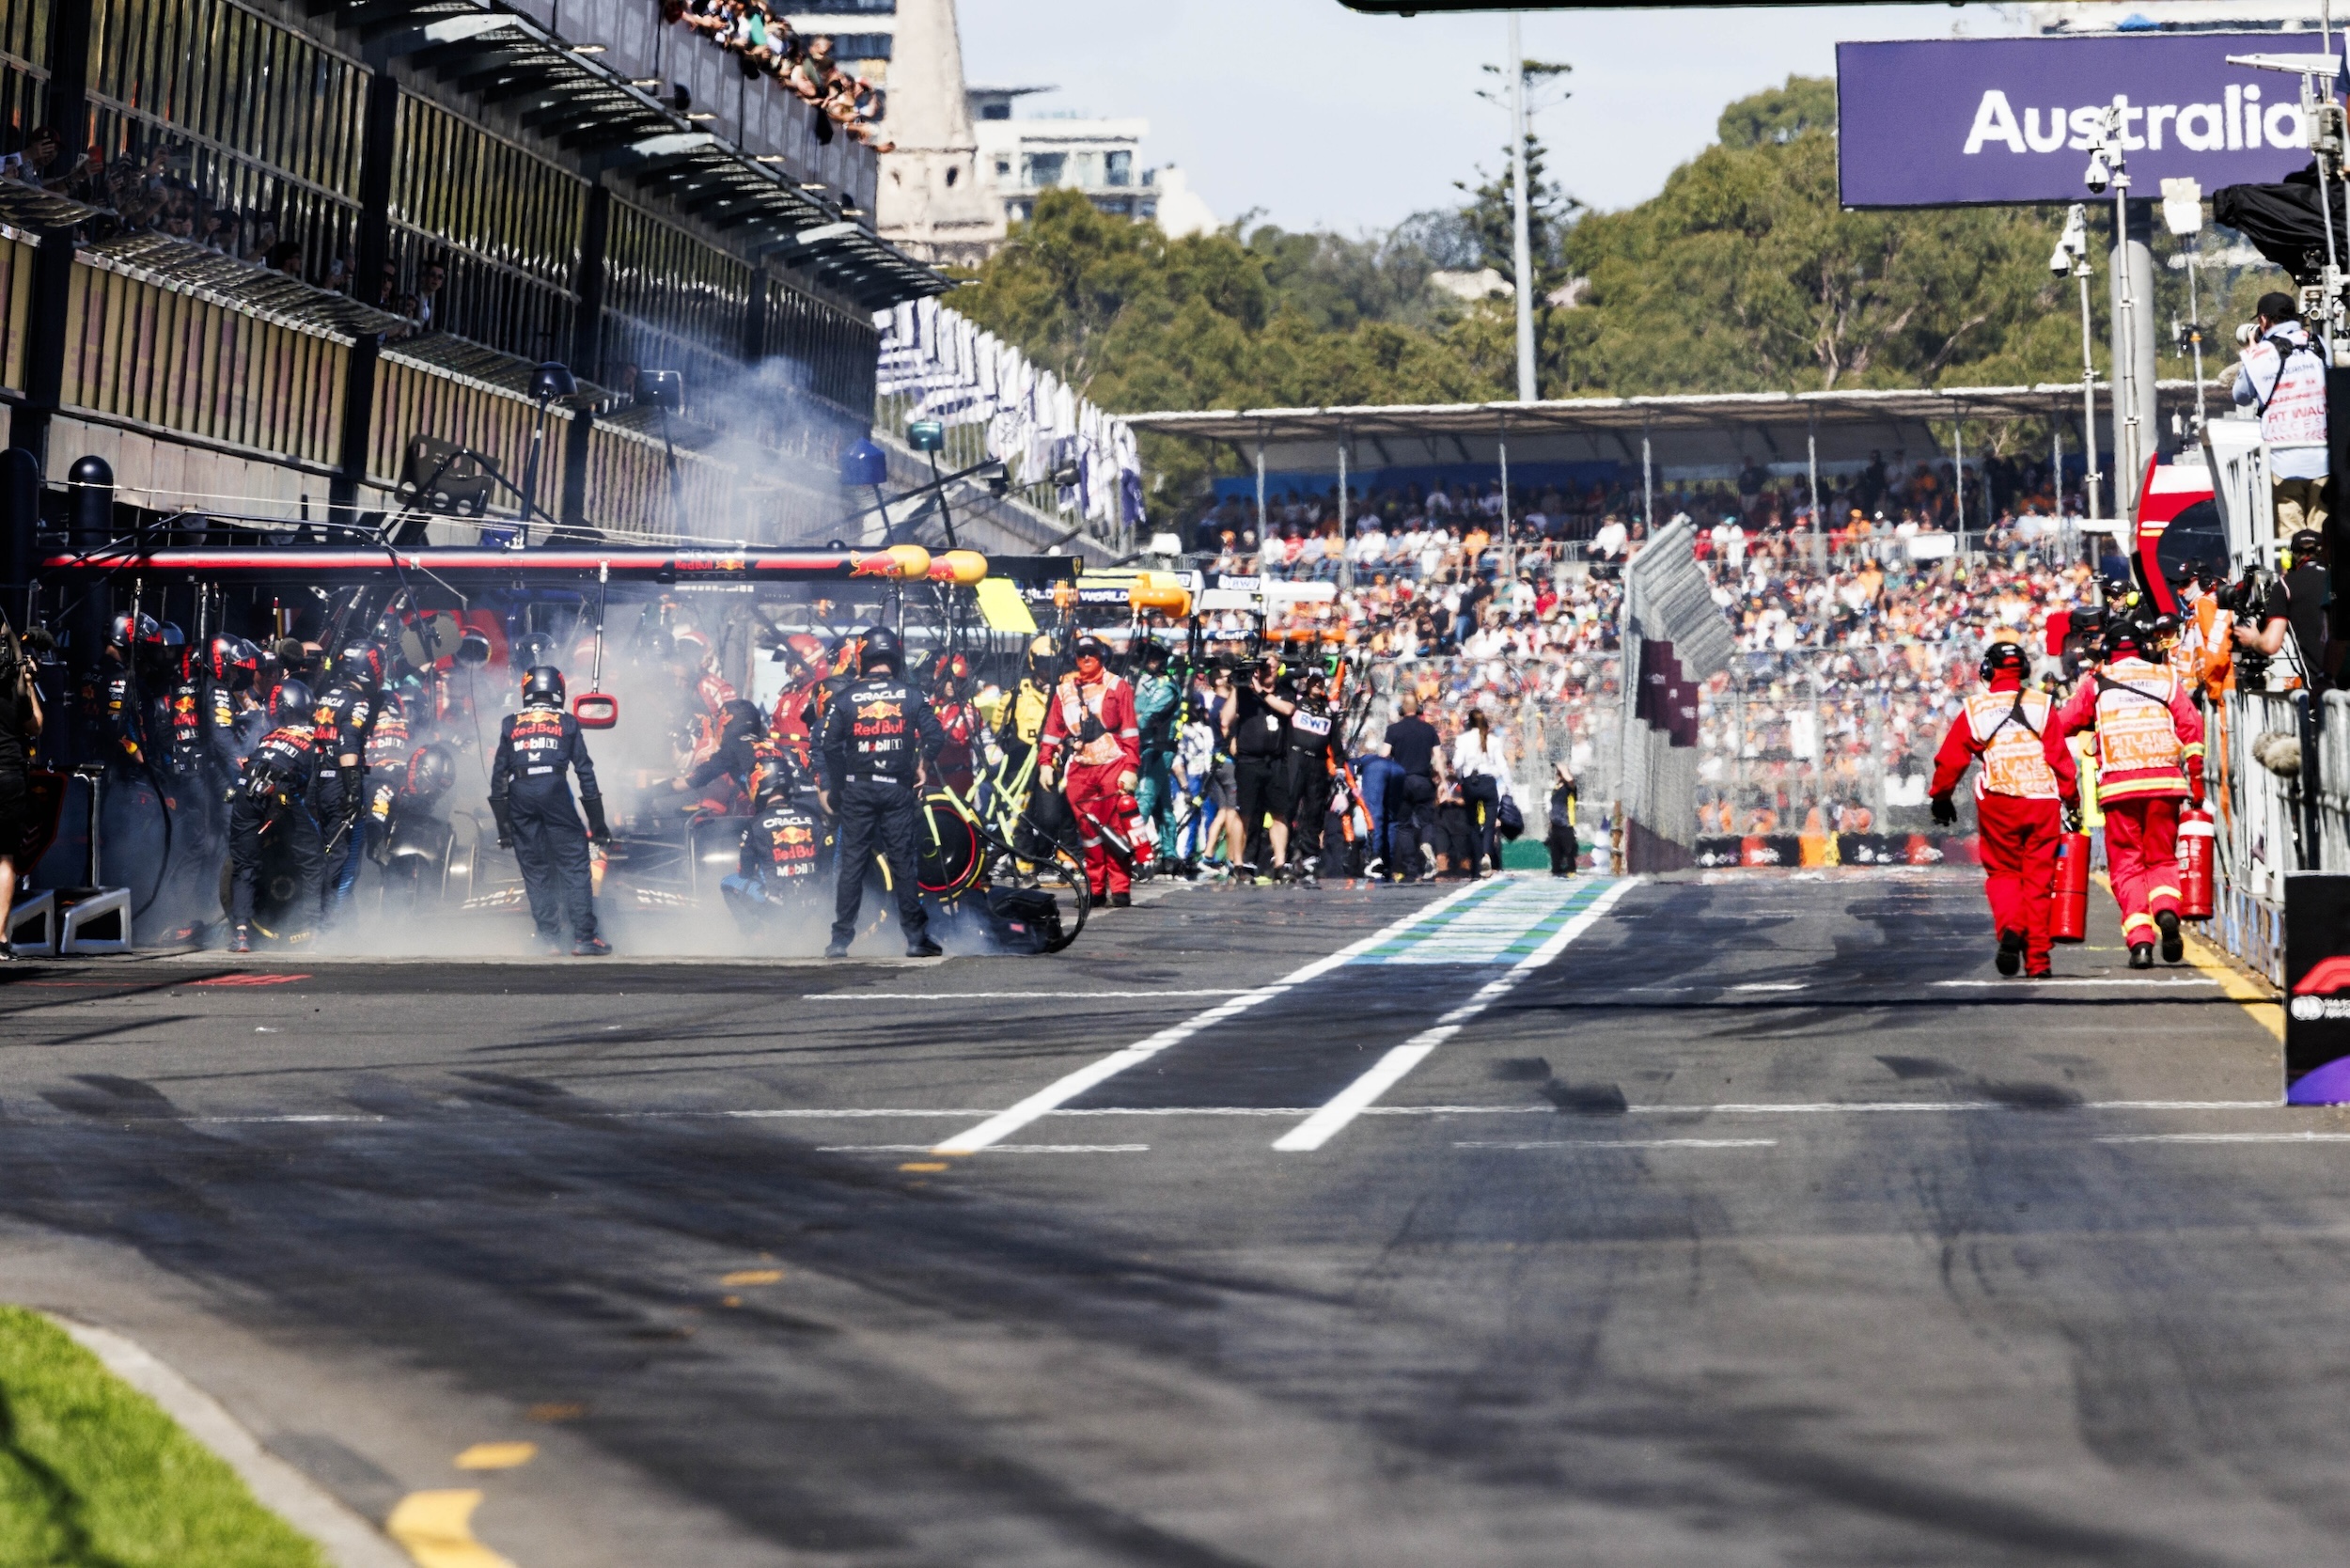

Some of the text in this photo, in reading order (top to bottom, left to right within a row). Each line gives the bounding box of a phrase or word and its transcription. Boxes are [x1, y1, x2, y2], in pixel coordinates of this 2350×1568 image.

[1963, 83, 2309, 154] Australia
[1080, 589, 1128, 602] WORLD
[852, 689, 906, 702] ORACLE
[854, 721, 880, 736] Red
[1300, 714, 1329, 732] BWT
[511, 723, 562, 740] Red Bull
[514, 737, 545, 752] Mobil
[858, 740, 890, 753] Mobil
[763, 817, 813, 828] ORACLE
[773, 845, 796, 862] Red
[776, 863, 808, 877] Mobil
